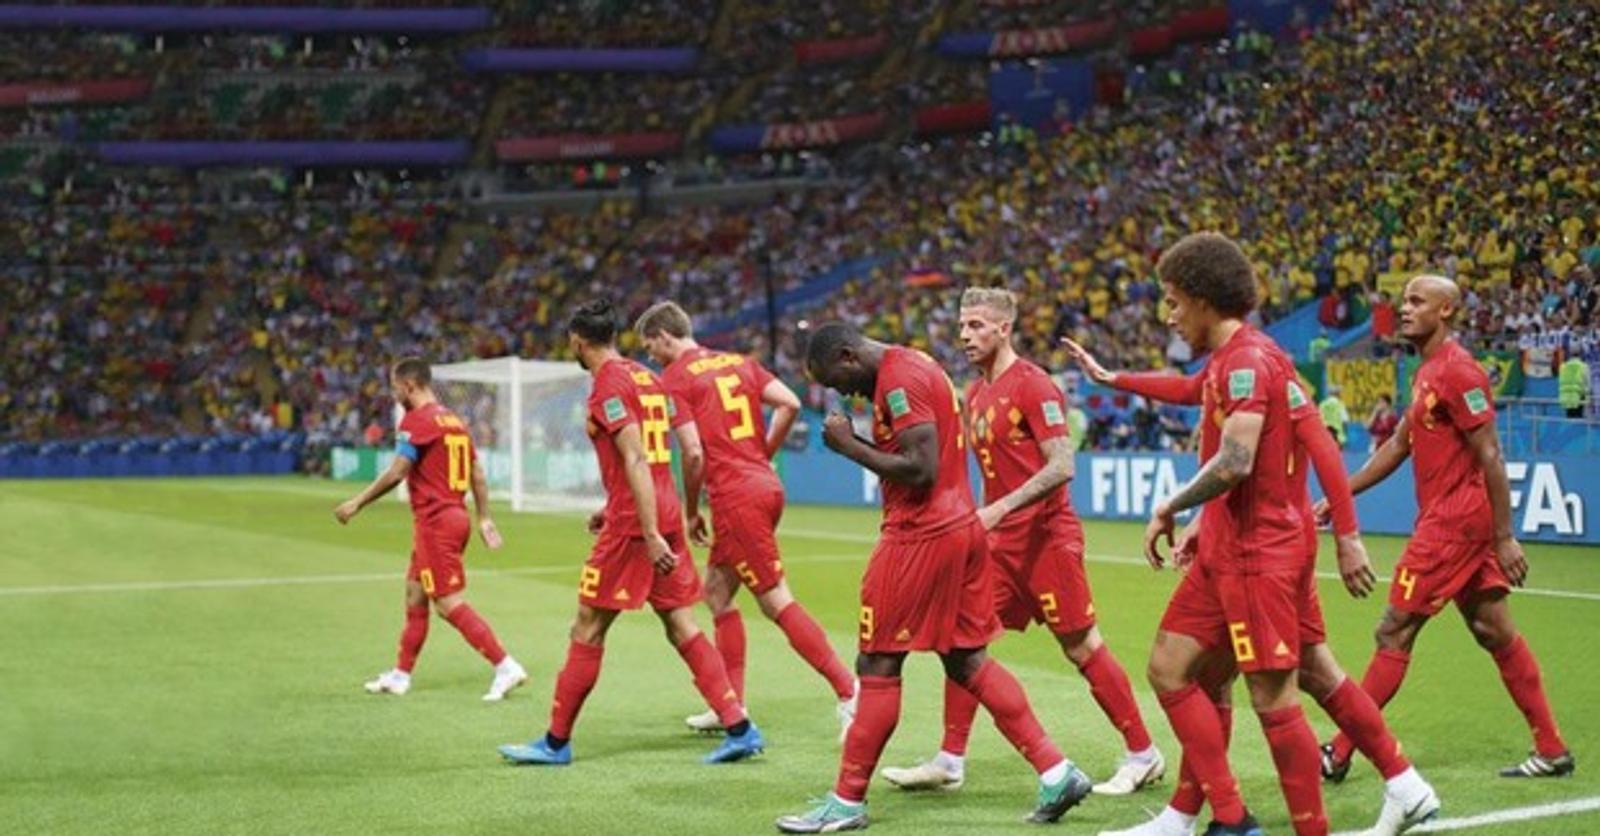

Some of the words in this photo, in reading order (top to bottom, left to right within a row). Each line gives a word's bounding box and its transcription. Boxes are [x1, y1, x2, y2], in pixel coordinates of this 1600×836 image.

[714, 374, 755, 441] 5
[639, 394, 671, 463] 22
[443, 433, 470, 491] 10
[980, 448, 995, 479] 2
[1091, 457, 1192, 517] FIFA
[735, 561, 759, 587] 5
[1398, 566, 1416, 601] 4
[859, 605, 874, 640] 9
[1039, 592, 1060, 623] 2
[1230, 622, 1256, 662] 6
